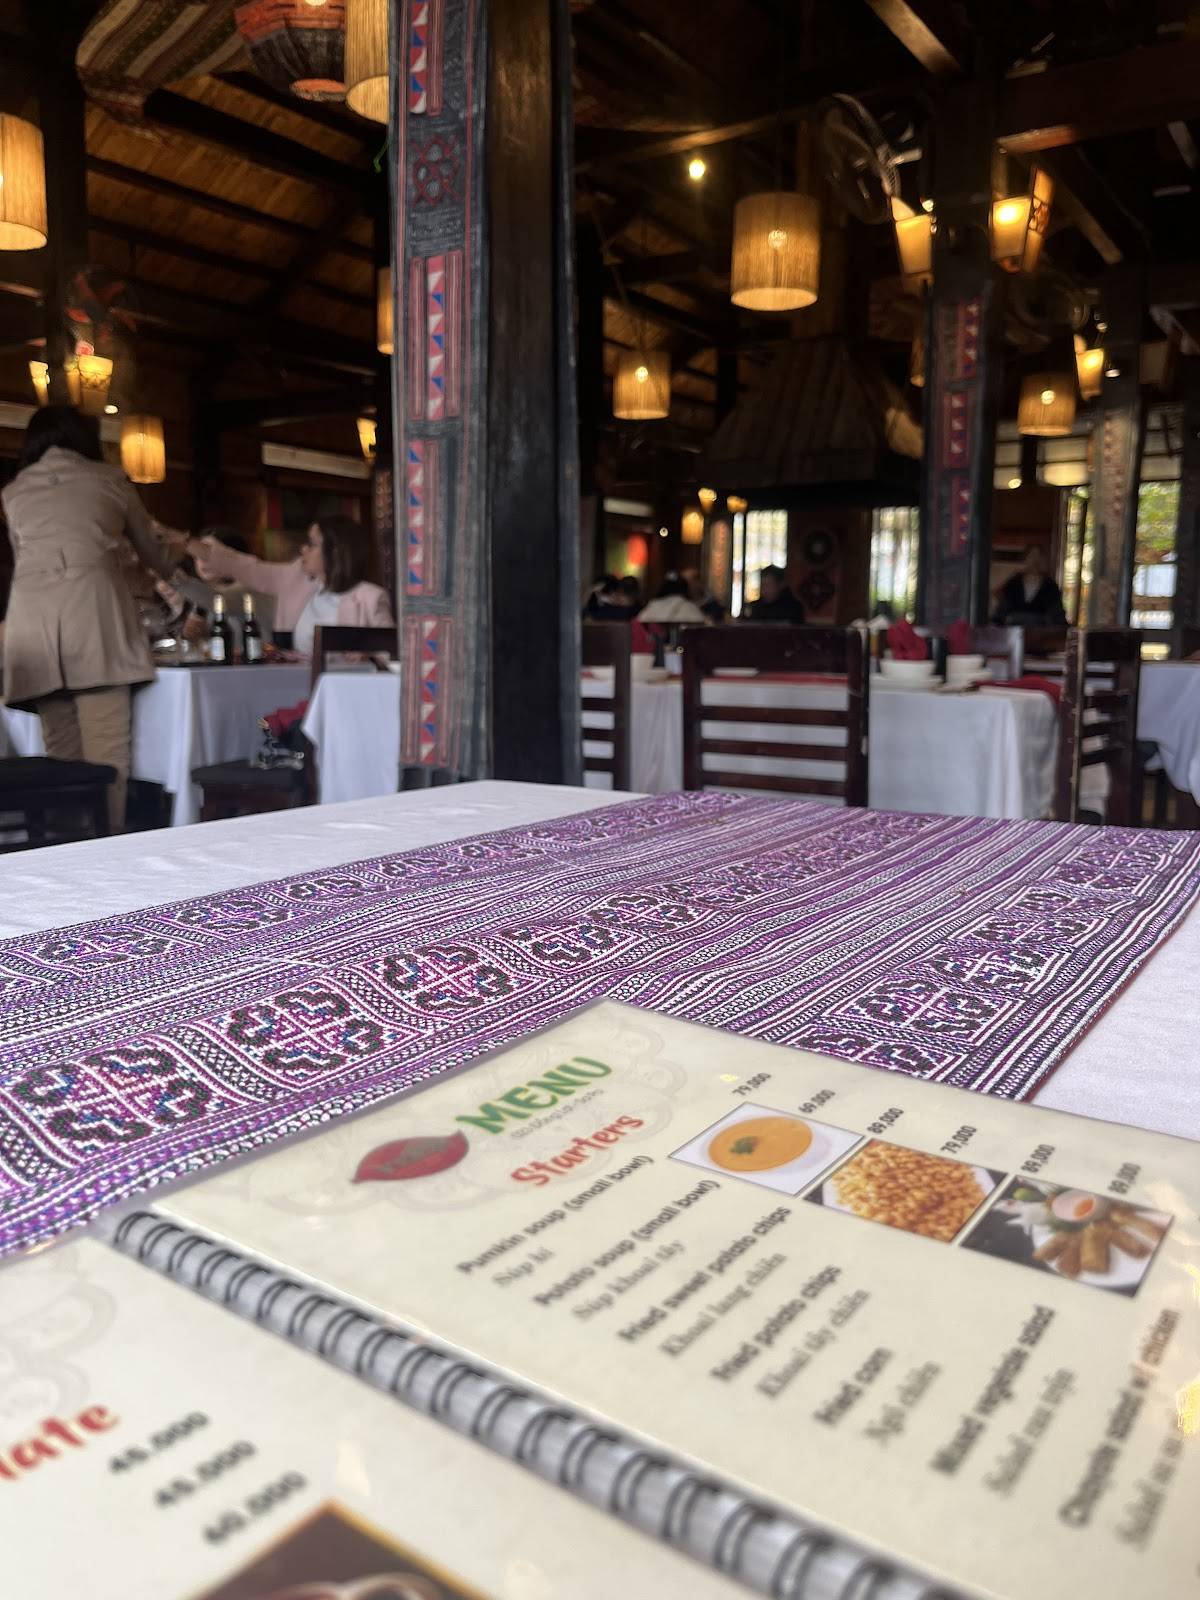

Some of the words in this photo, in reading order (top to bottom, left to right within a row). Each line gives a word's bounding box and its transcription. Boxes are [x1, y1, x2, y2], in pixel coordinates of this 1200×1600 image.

[456, 1056, 612, 1134] MENU
[732, 1073, 771, 1095] 79,000
[511, 1114, 644, 1187] Starters
[940, 1126, 977, 1154] 79,000
[456, 1235, 526, 1274] Pumkin
[523, 1210, 566, 1235] soup
[563, 1179, 613, 1211] (small
[606, 1156, 654, 1181] bowl)
[533, 1267, 596, 1307] Potato
[593, 1240, 635, 1268] soup
[631, 1206, 680, 1241] (small
[673, 1180, 720, 1209] bowl)
[707, 1236, 757, 1274] potato
[752, 1207, 791, 1236] chips
[754, 1299, 807, 1348] potato
[800, 1266, 842, 1300] chips
